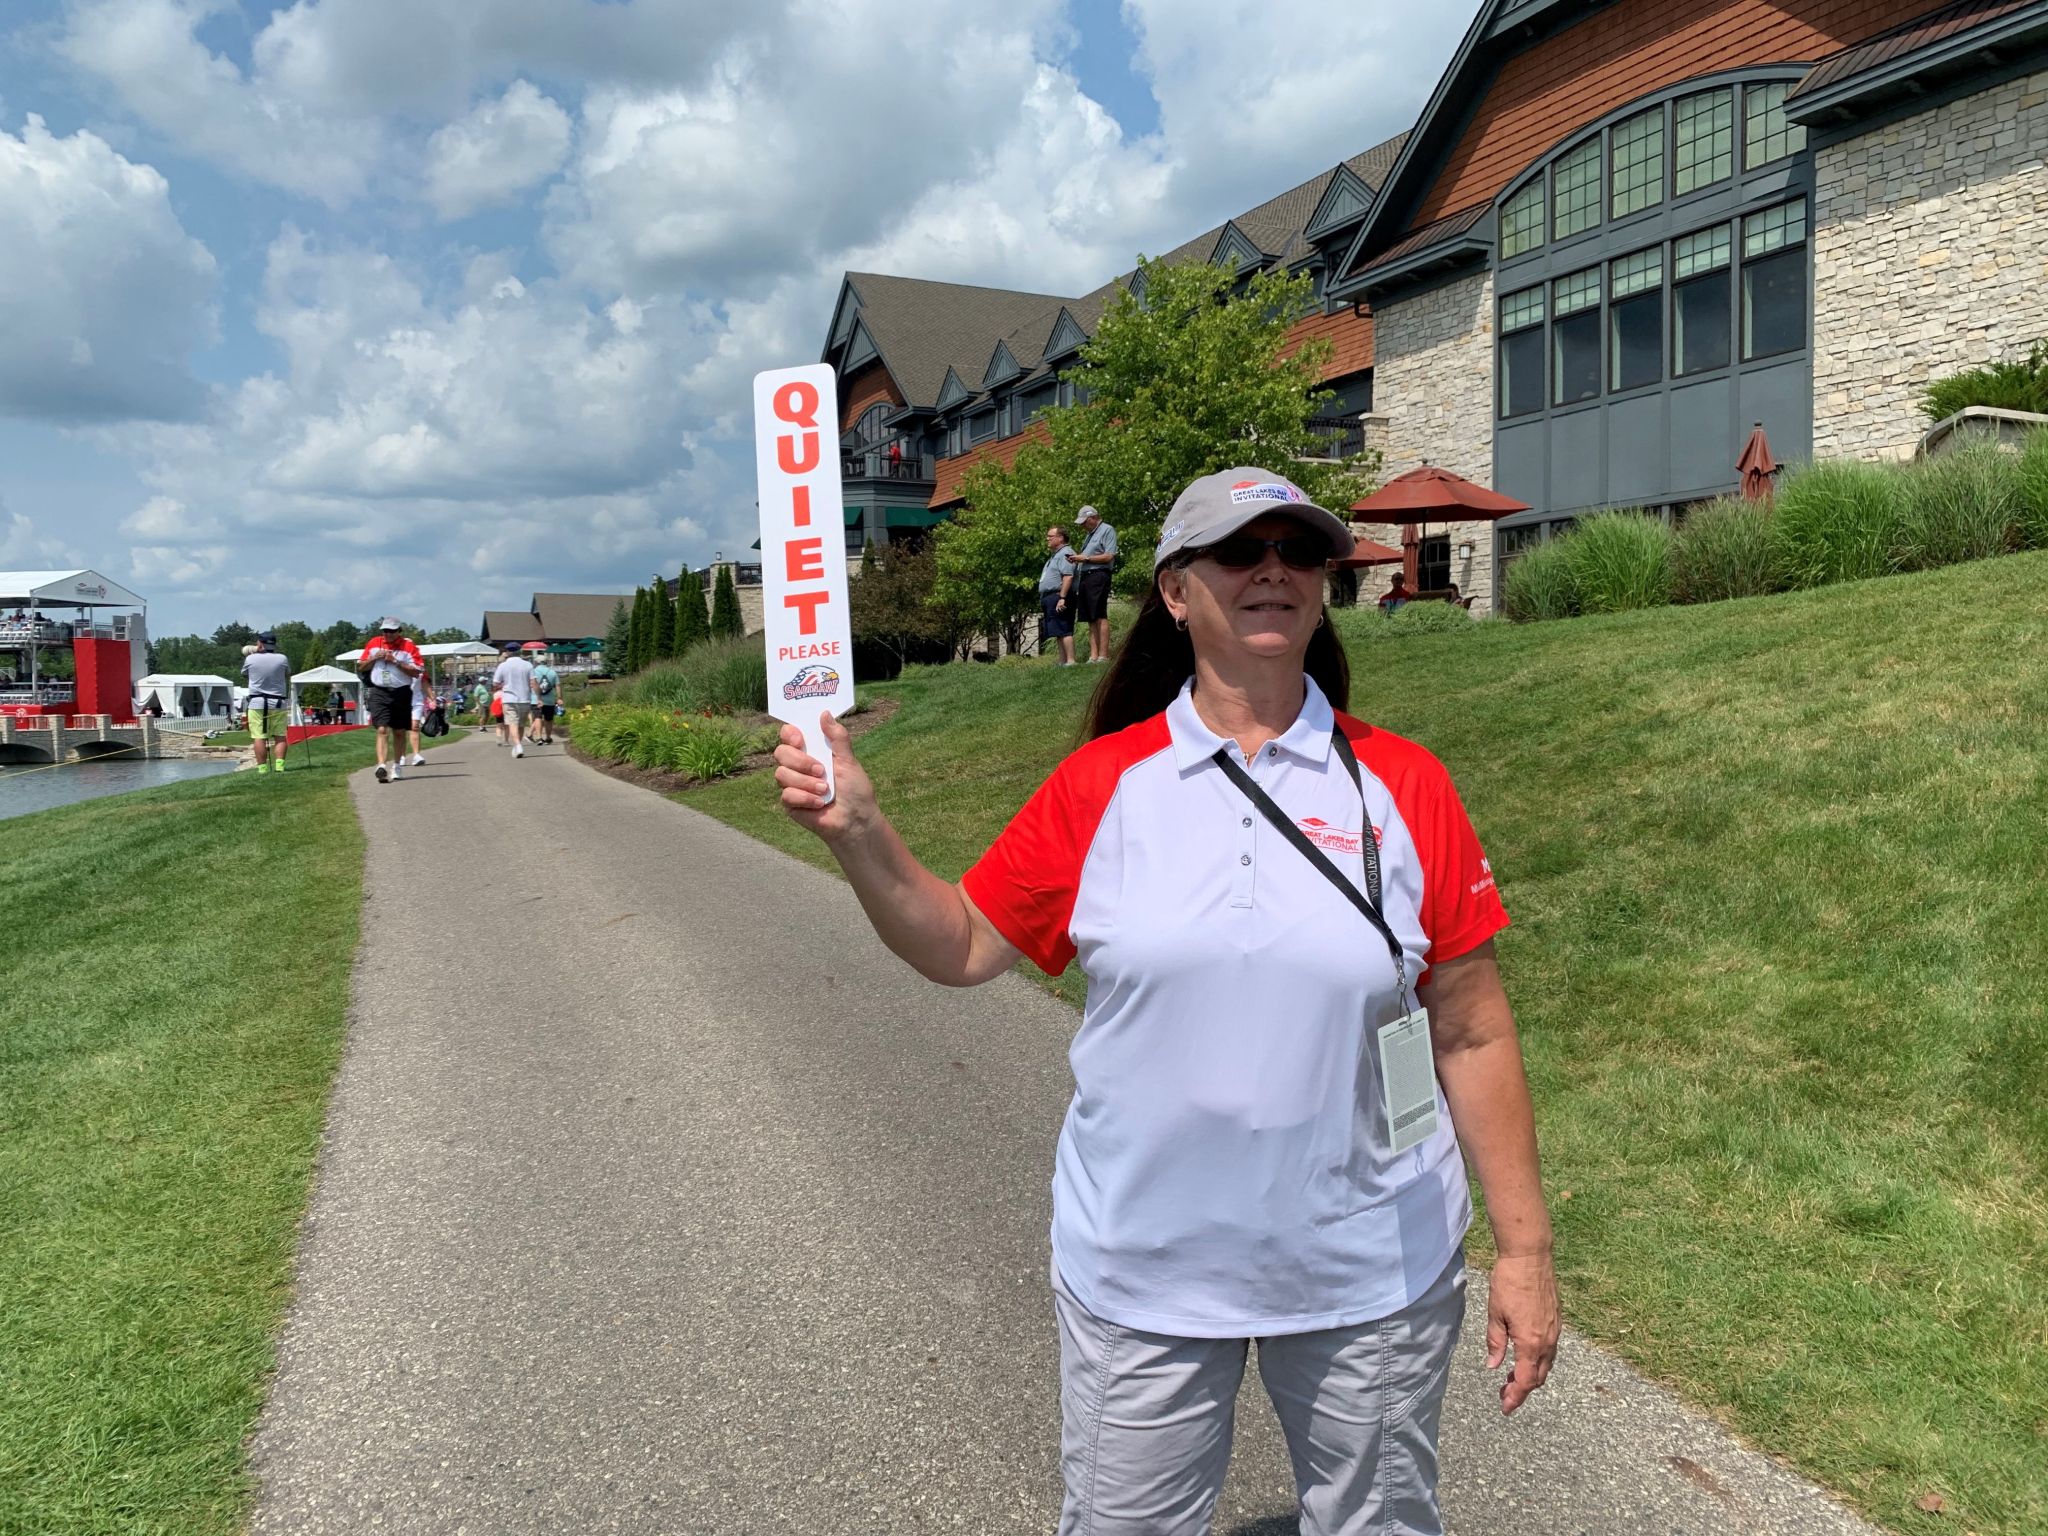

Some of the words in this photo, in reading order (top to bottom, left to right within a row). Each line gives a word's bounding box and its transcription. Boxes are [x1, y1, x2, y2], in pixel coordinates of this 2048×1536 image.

[1233, 489, 1254, 497] GREAT
[1234, 493, 1289, 502] INVITATIONAL
[771, 380, 830, 636] QUIET
[779, 641, 841, 661] PLEASE
[1323, 833, 1345, 842] LAKES
[1365, 839, 1379, 901] INVITATIONAL
